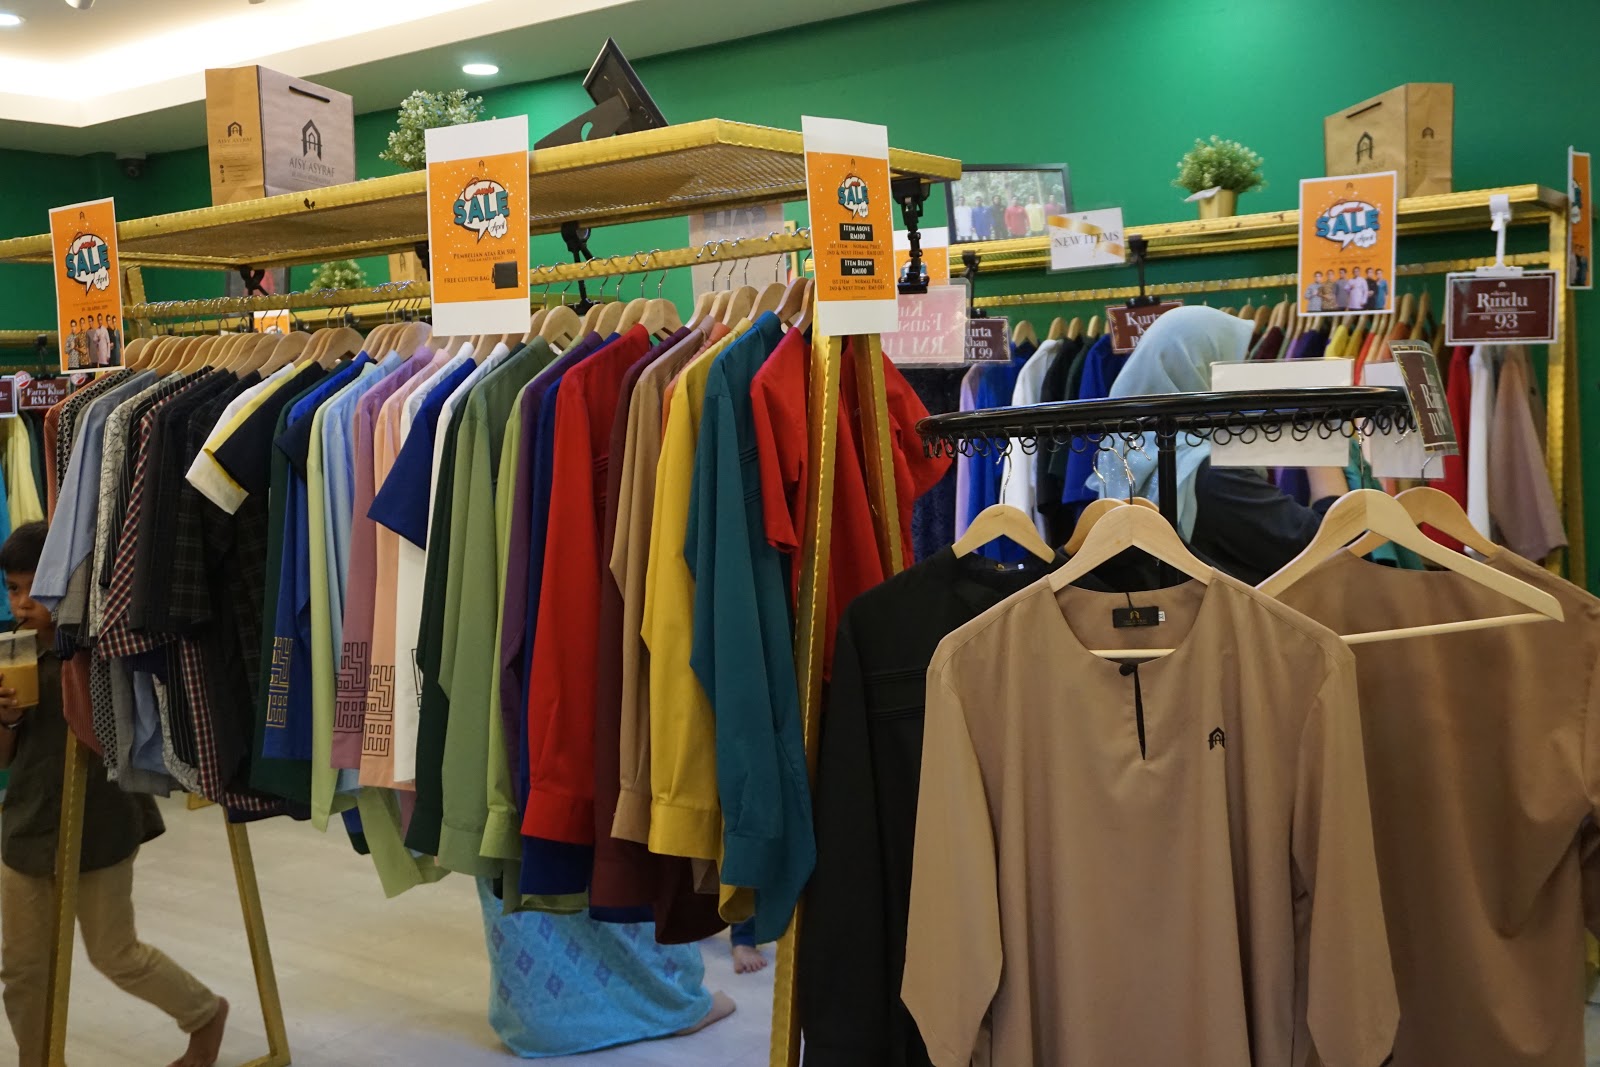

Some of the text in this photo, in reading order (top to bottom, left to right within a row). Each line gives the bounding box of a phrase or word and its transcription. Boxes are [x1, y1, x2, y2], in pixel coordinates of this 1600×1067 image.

[289, 157, 307, 170] AISY
[308, 163, 335, 178] ASYRAF
[838, 186, 869, 206] SALE
[453, 190, 510, 225] SALE
[490, 221, 505, 234] April
[843, 224, 855, 232] ITEM
[1315, 209, 1380, 238] SALE
[1054, 231, 1119, 248] NEW ITEMS
[65, 244, 110, 279] SALE
[457, 275, 479, 283] CLUTCH
[851, 267, 867, 275] RM100
[1477, 291, 1528, 308] Rindu
[1494, 313, 1519, 330] 93
[965, 326, 992, 337] urta
[978, 347, 993, 359] 99
[31, 396, 46, 405] RM
